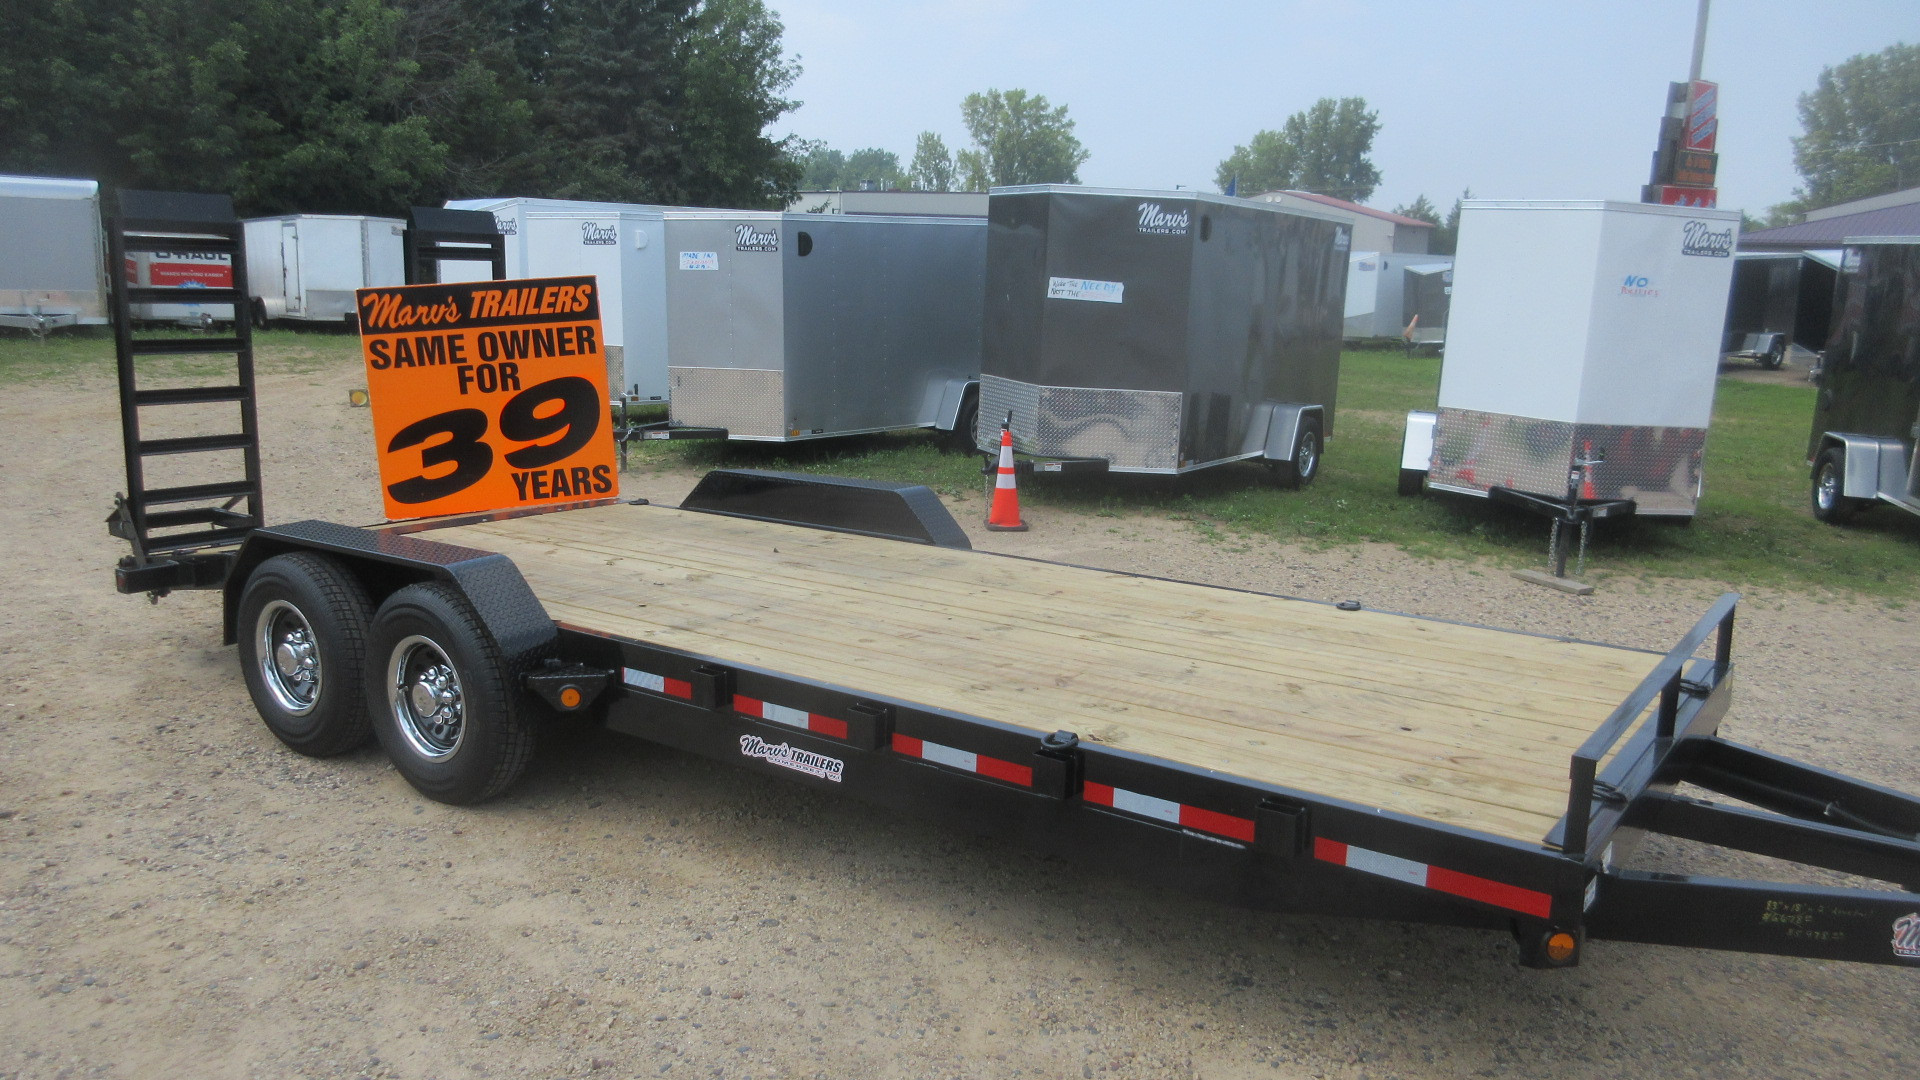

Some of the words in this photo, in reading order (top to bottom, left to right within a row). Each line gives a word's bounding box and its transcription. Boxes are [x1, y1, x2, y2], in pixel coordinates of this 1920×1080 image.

[1137, 203, 1190, 228] Marv's
[581, 221, 618, 241] Marv's
[735, 224, 779, 246] Marv's
[1138, 227, 1187, 235] TRAILERS.COM
[1683, 220, 1733, 250] Marv's
[1051, 288, 1066, 296] NOT
[1624, 275, 1649, 288] NO
[363, 293, 461, 329] Marv's
[470, 284, 592, 319] TRAILERS
[369, 334, 467, 370] SAME
[477, 325, 597, 362] OWNER
[457, 362, 521, 395] FOR
[387, 375, 601, 504] 39
[511, 464, 613, 501] YEARS
[742, 737, 788, 757] Marv's
[791, 750, 841, 773] TRAILERS
